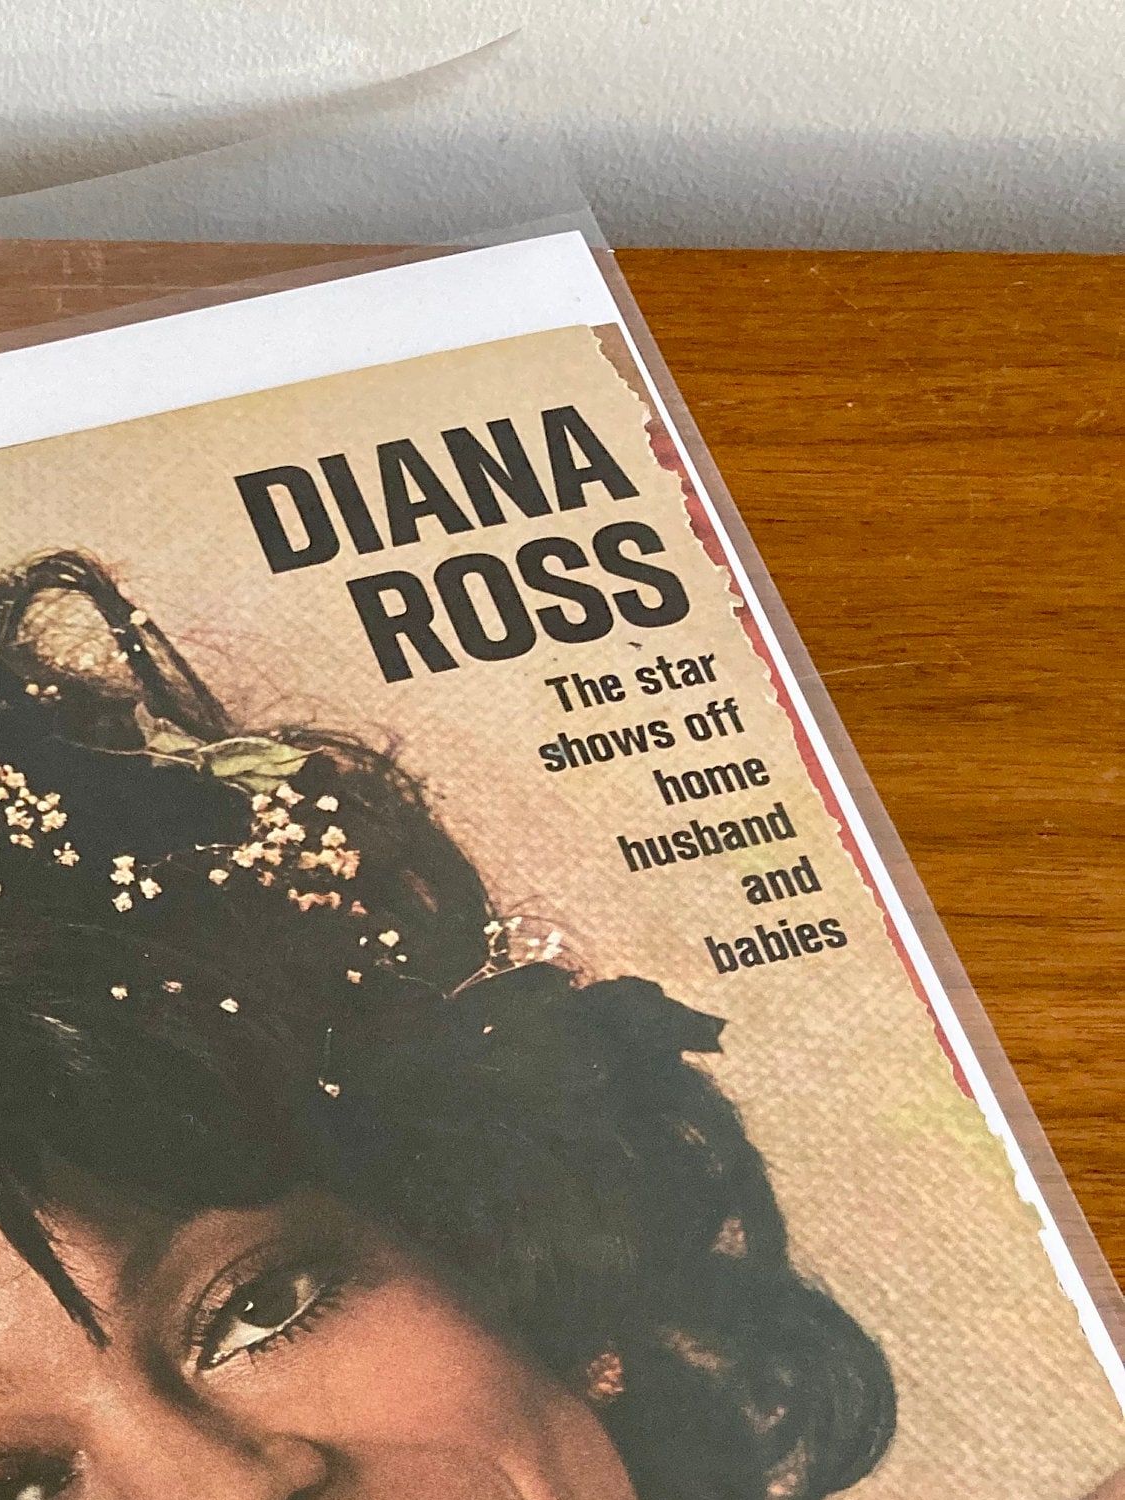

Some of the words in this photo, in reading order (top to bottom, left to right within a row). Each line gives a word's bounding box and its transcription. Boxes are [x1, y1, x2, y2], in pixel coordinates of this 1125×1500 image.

[233, 405, 640, 574] DIANA
[346, 521, 690, 683] ROSS
[544, 672, 626, 713] The
[636, 652, 716, 696] star
[538, 719, 676, 773] shows
[683, 697, 745, 742] off
[652, 757, 771, 806] home
[617, 802, 797, 872] husband
[741, 856, 822, 906] and
[704, 917, 848, 975] babies
